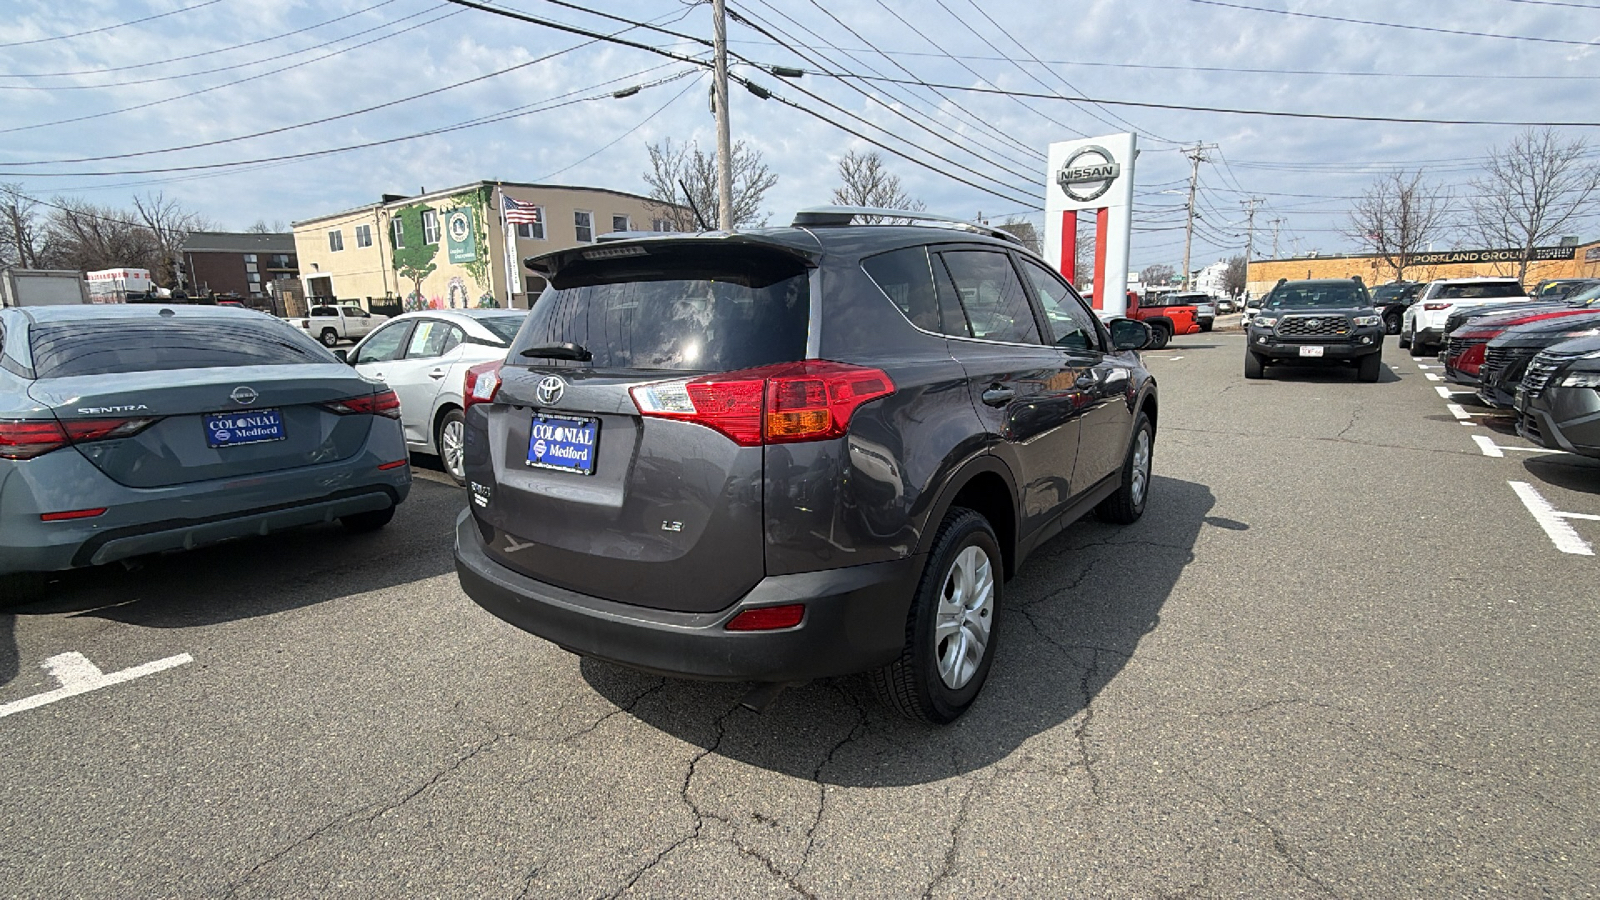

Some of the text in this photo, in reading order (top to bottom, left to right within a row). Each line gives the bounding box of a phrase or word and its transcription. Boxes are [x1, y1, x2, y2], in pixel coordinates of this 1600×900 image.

[1061, 166, 1113, 180] NISSAN
[1413, 252, 1479, 263] PORTLAND
[77, 404, 149, 414] SENTRA
[209, 416, 279, 430] COLONIAL
[235, 426, 278, 437] Medford
[533, 424, 593, 445] COLONIAL
[549, 444, 588, 461] Medford
[661, 520, 683, 531] LE
